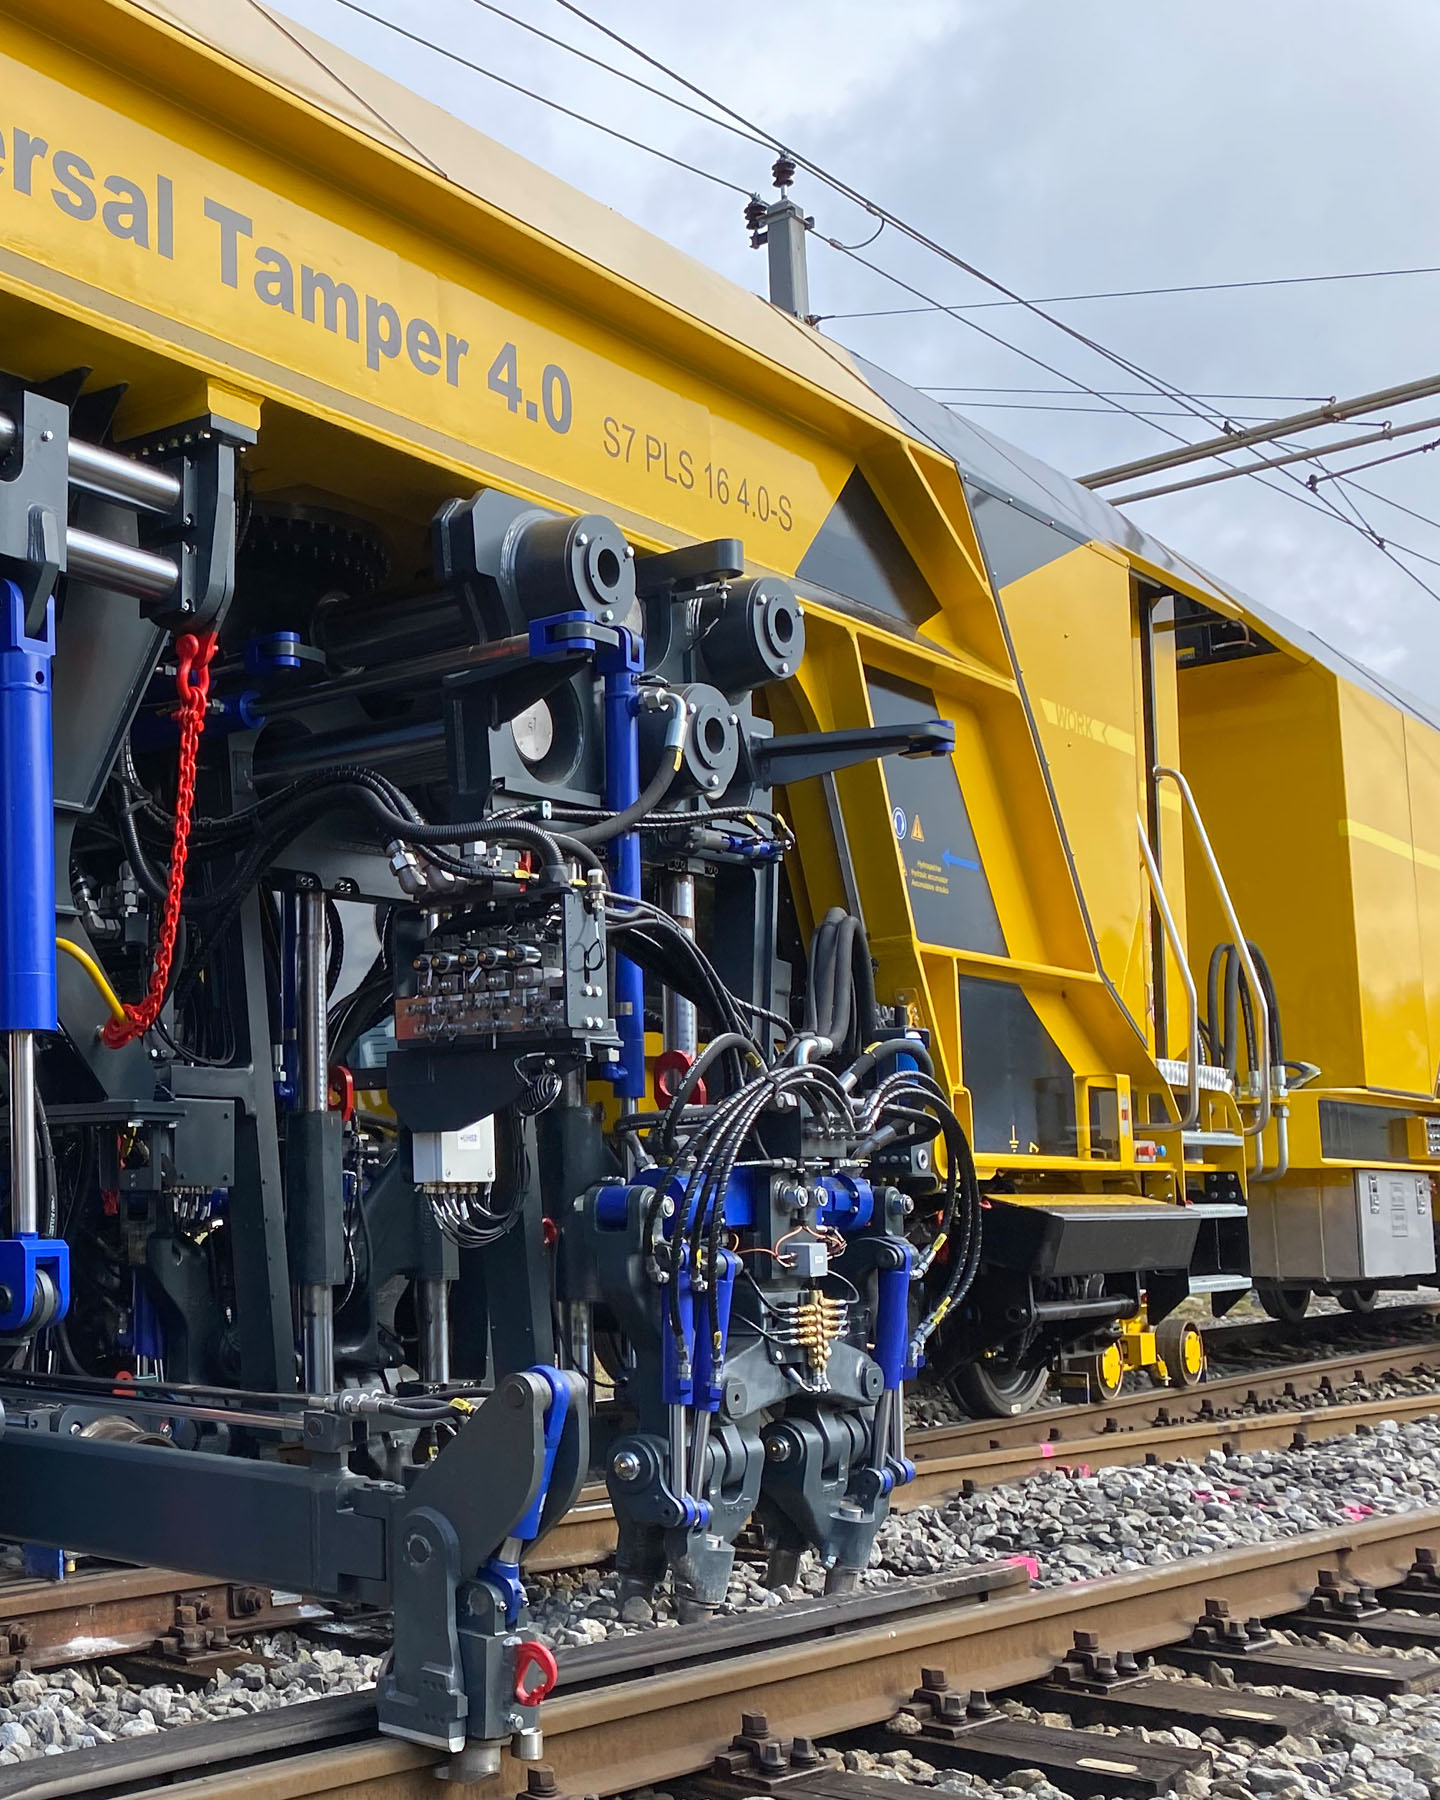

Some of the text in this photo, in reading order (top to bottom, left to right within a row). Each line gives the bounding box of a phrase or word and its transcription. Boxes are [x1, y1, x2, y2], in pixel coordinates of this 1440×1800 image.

[203, 196, 469, 388] Tamper
[487, 341, 573, 435] 4.0
[603, 416, 793, 532] S7 PLS 16 4.0-S
[1057, 703, 1094, 739] WORK
